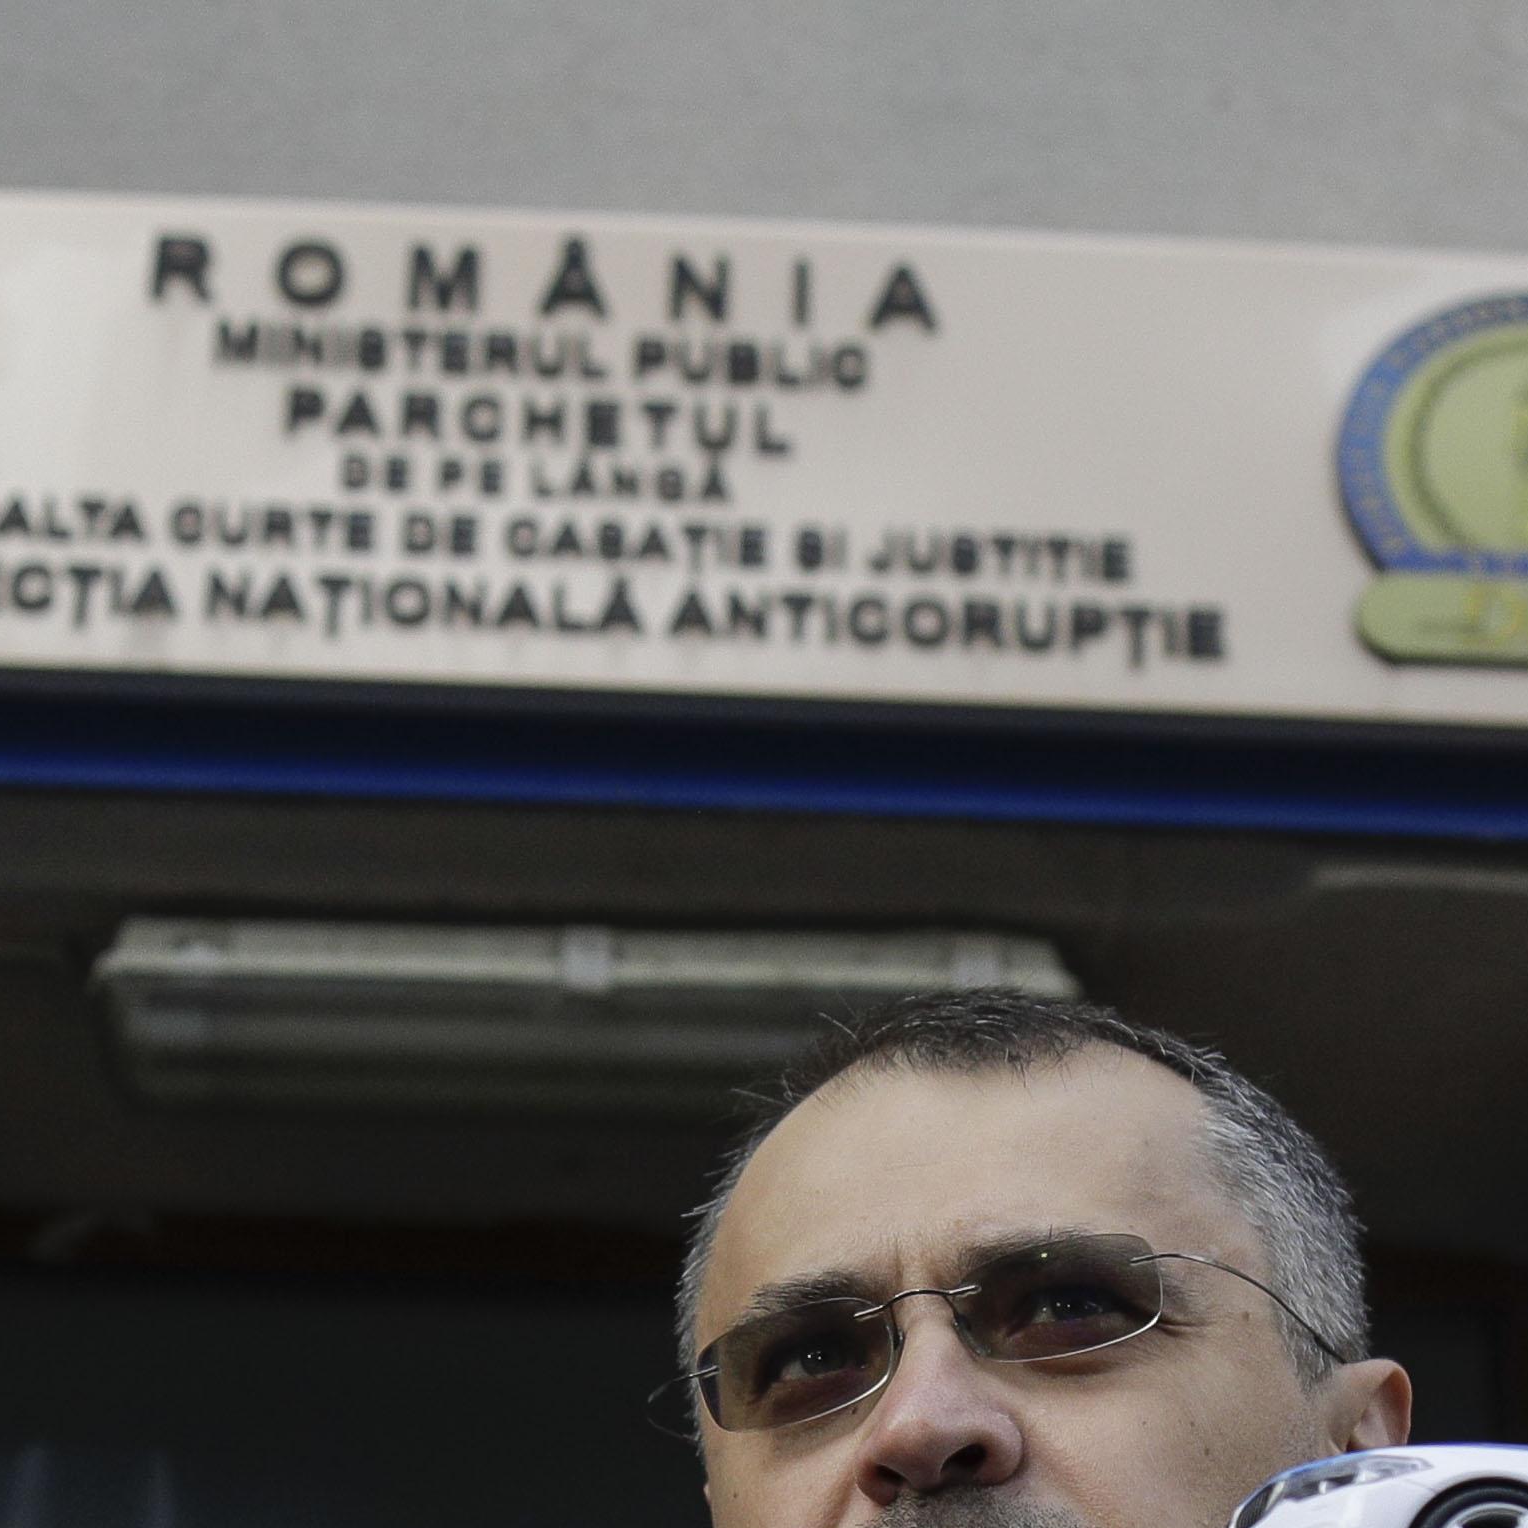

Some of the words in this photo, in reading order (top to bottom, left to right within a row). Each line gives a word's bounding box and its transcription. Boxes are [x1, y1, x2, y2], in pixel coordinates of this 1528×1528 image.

[215, 321, 607, 380] MINISTERUL
[632, 338, 868, 389] PUBLIC
[283, 386, 791, 455] PARCHETUL
[342, 454, 409, 493] DE
[438, 458, 504, 496] PE
[171, 502, 374, 552] CURTE
[404, 510, 476, 556] DE
